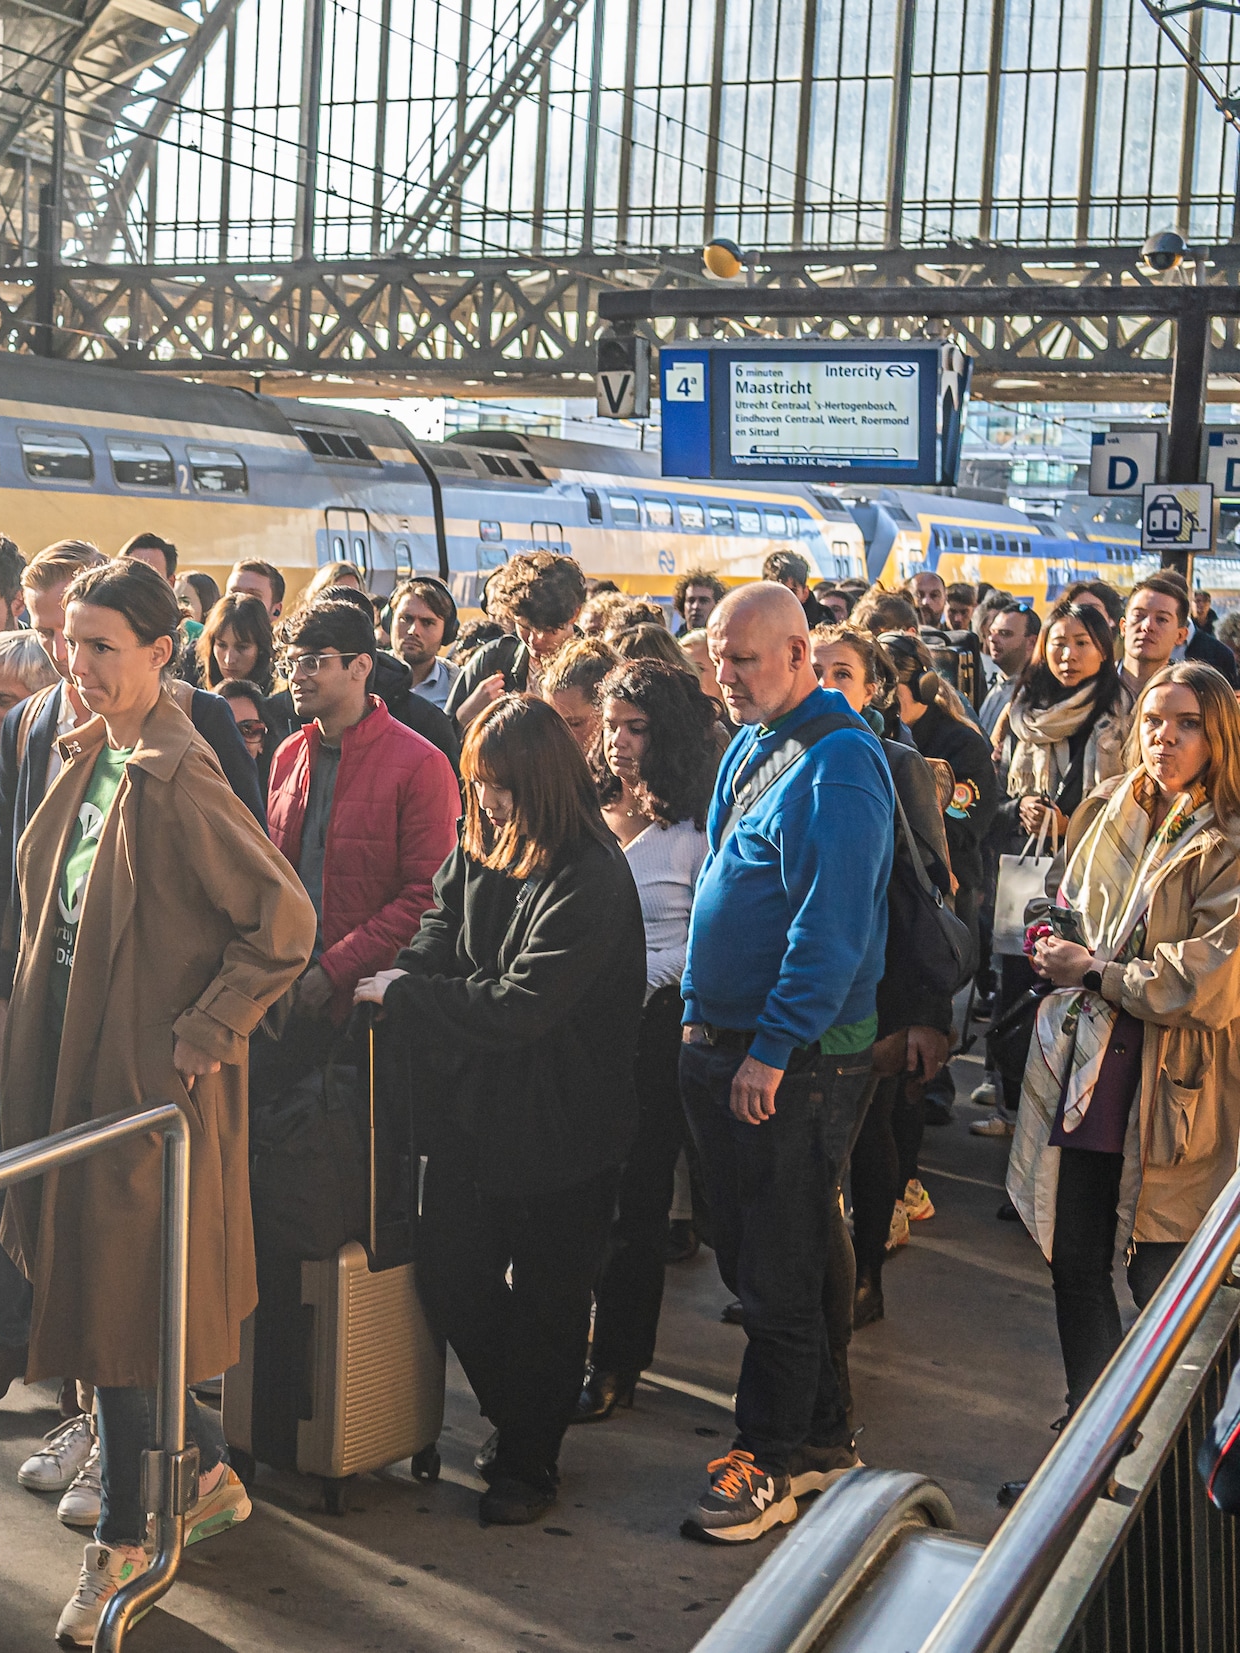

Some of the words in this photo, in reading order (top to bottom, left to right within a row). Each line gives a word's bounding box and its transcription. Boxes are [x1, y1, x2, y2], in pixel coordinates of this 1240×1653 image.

[735, 364, 743, 377] 6
[746, 367, 784, 377] minuten
[825, 363, 881, 381] Intercity
[601, 374, 631, 414] V
[735, 380, 813, 395] Maastricht
[735, 400, 769, 410] Utrecht
[735, 413, 782, 424] Eindhoven
[827, 415, 858, 426] Weert,
[861, 415, 910, 425] Roermond
[735, 429, 747, 437] en
[748, 427, 780, 437] Sittard
[178, 464, 190, 495] 2
[1107, 455, 1139, 490] D
